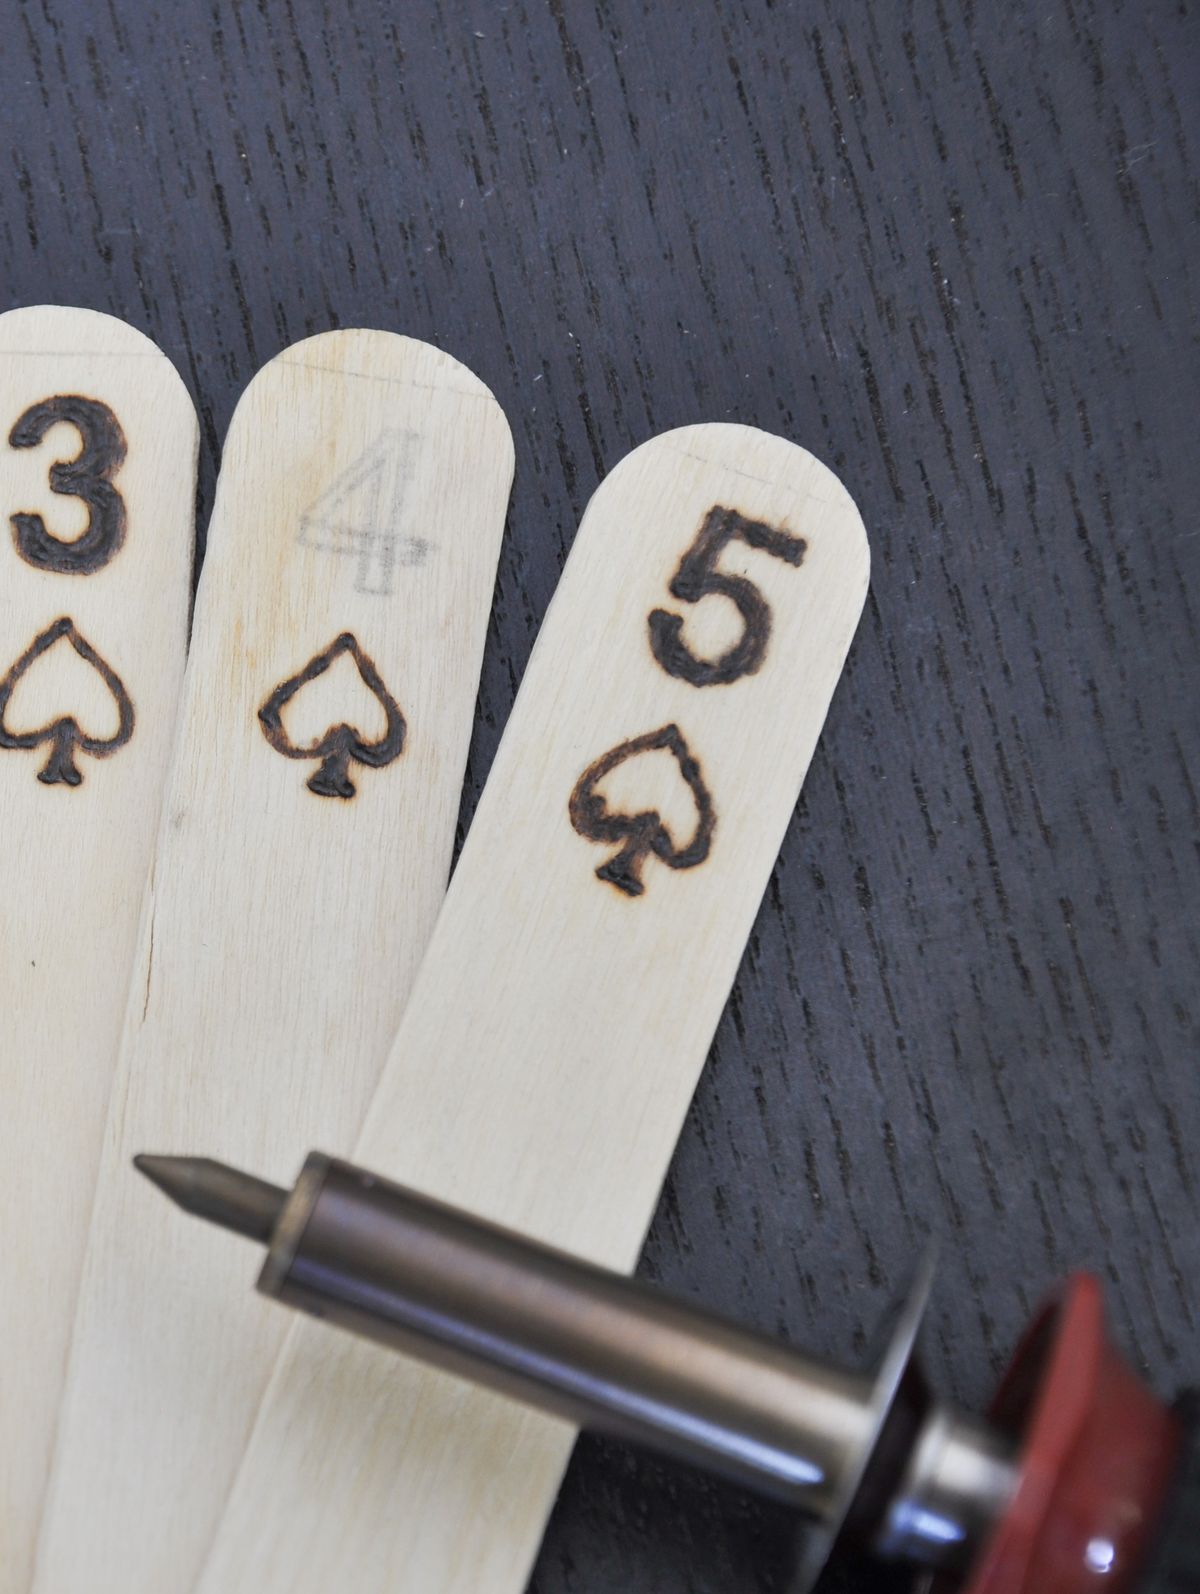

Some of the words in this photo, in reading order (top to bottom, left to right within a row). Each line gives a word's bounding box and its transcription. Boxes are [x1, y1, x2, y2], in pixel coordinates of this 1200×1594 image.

[8, 394, 129, 576] 3
[299, 428, 437, 595] 4
[647, 505, 809, 689] 5
